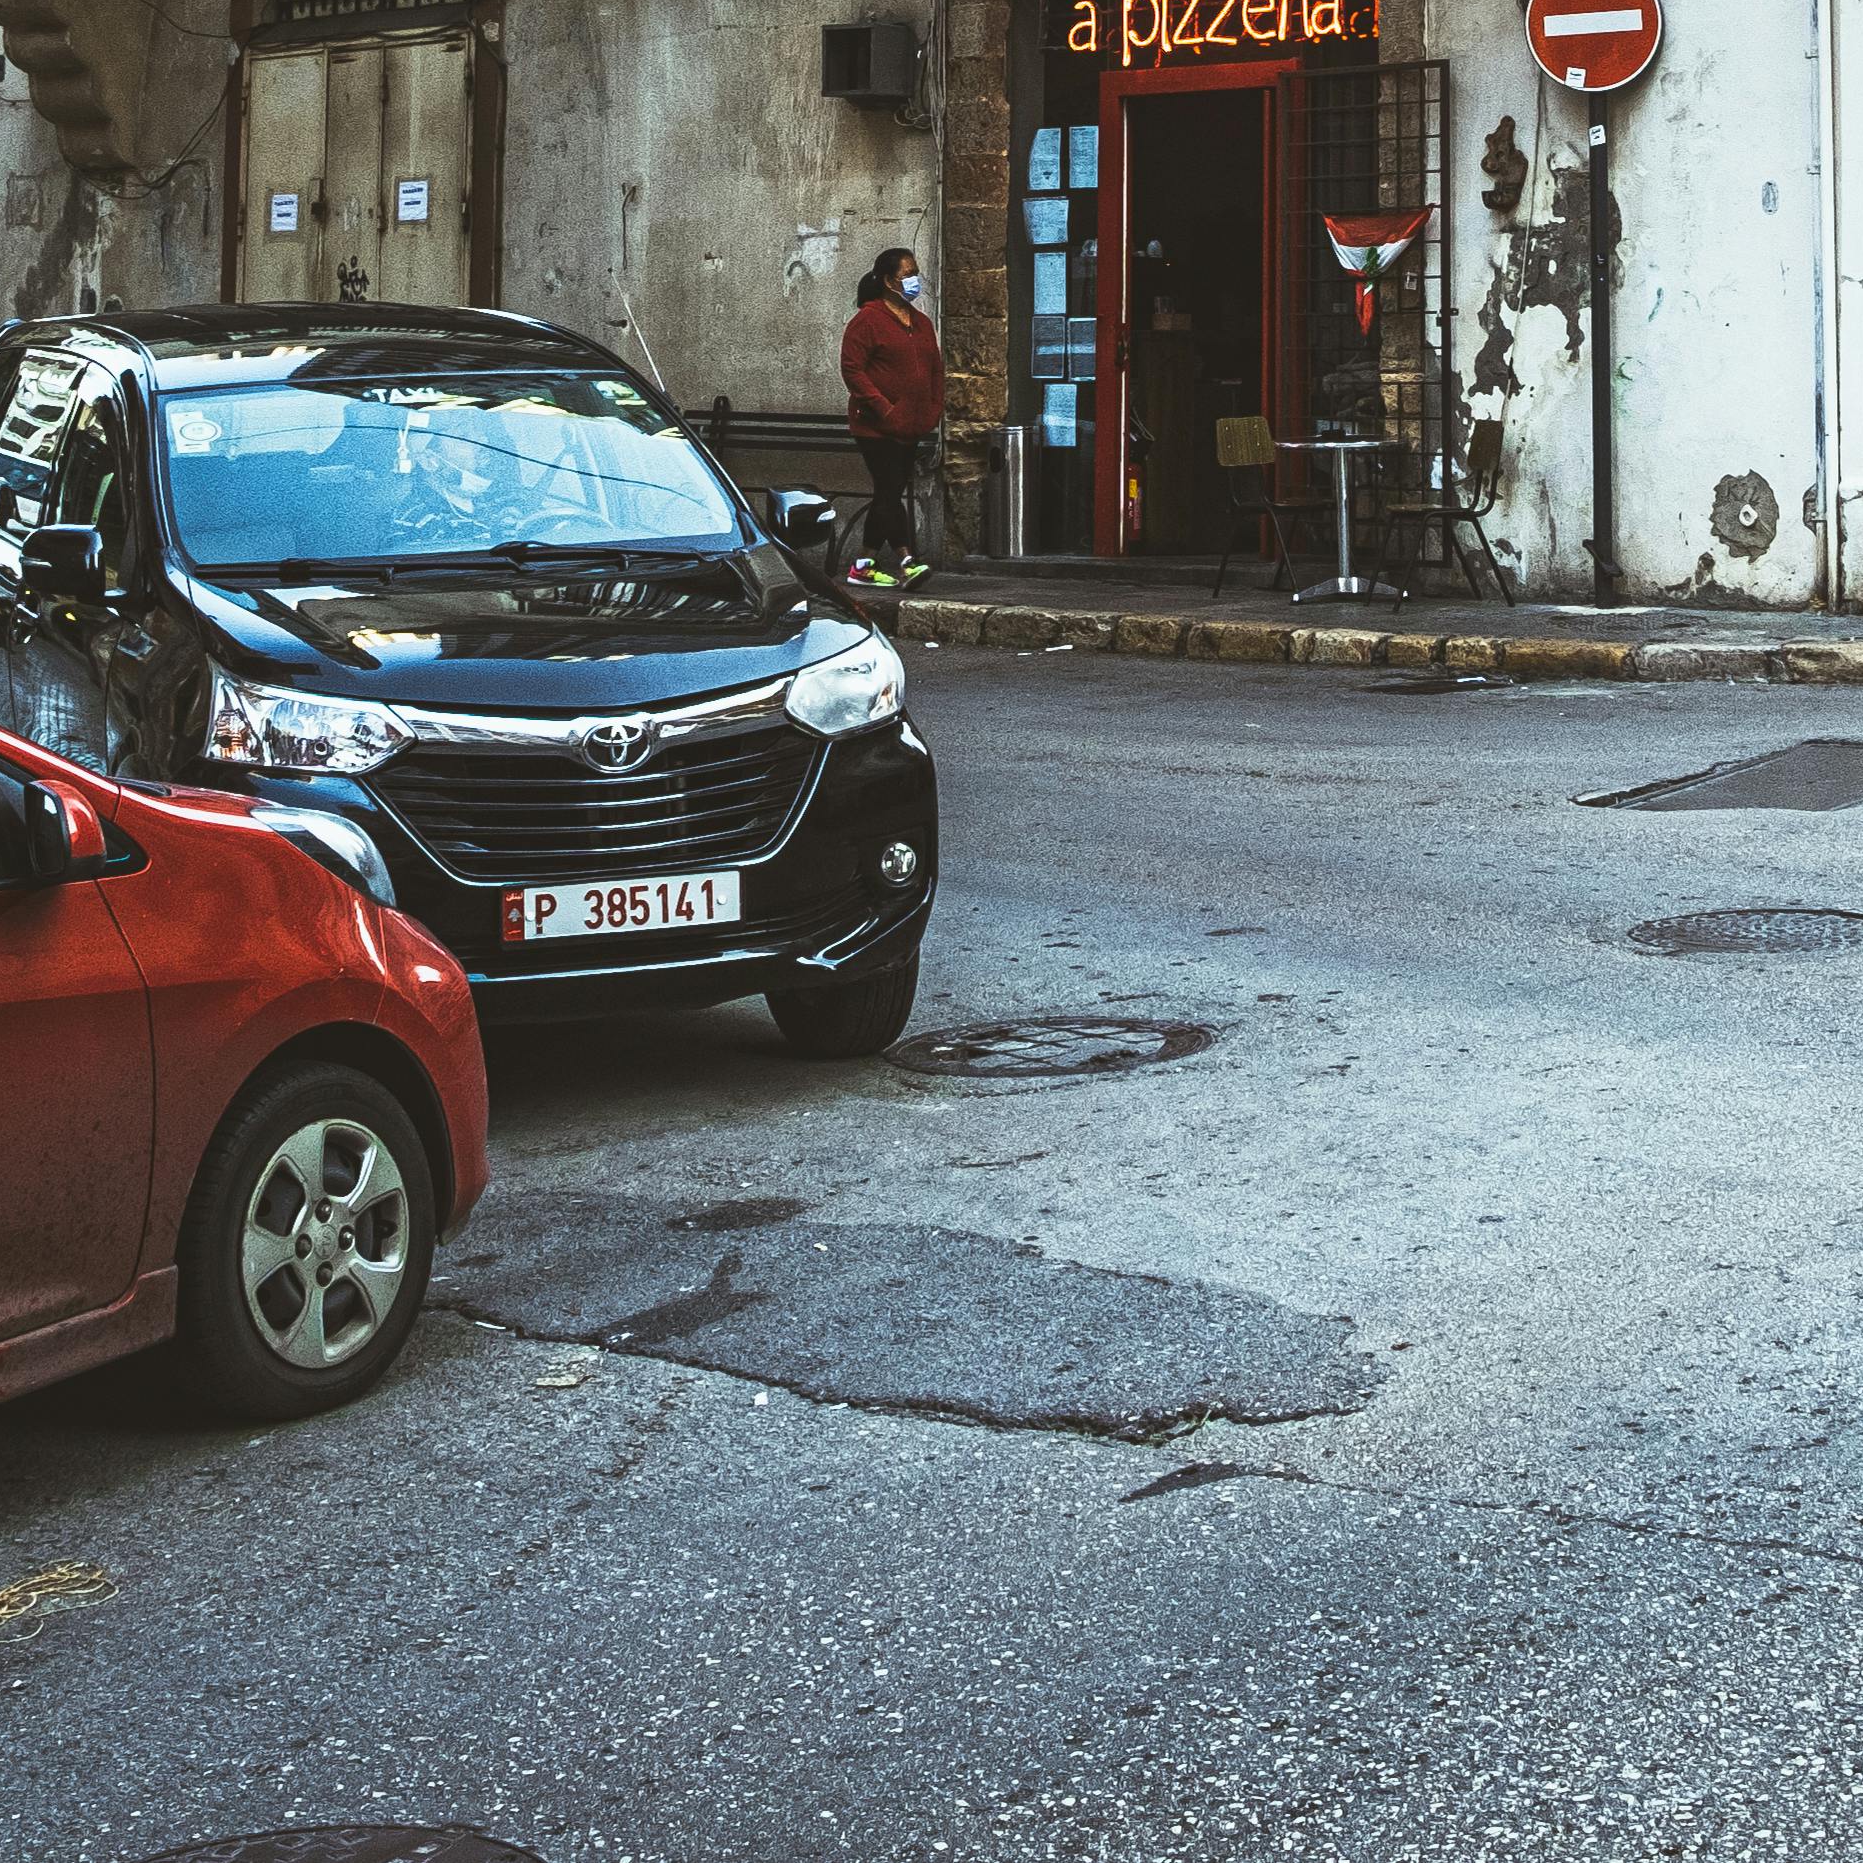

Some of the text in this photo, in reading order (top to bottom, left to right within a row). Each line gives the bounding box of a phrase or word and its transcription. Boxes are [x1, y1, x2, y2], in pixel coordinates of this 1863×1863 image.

[1068, 0, 1097, 52] a
[535, 878, 715, 935] P 385141
